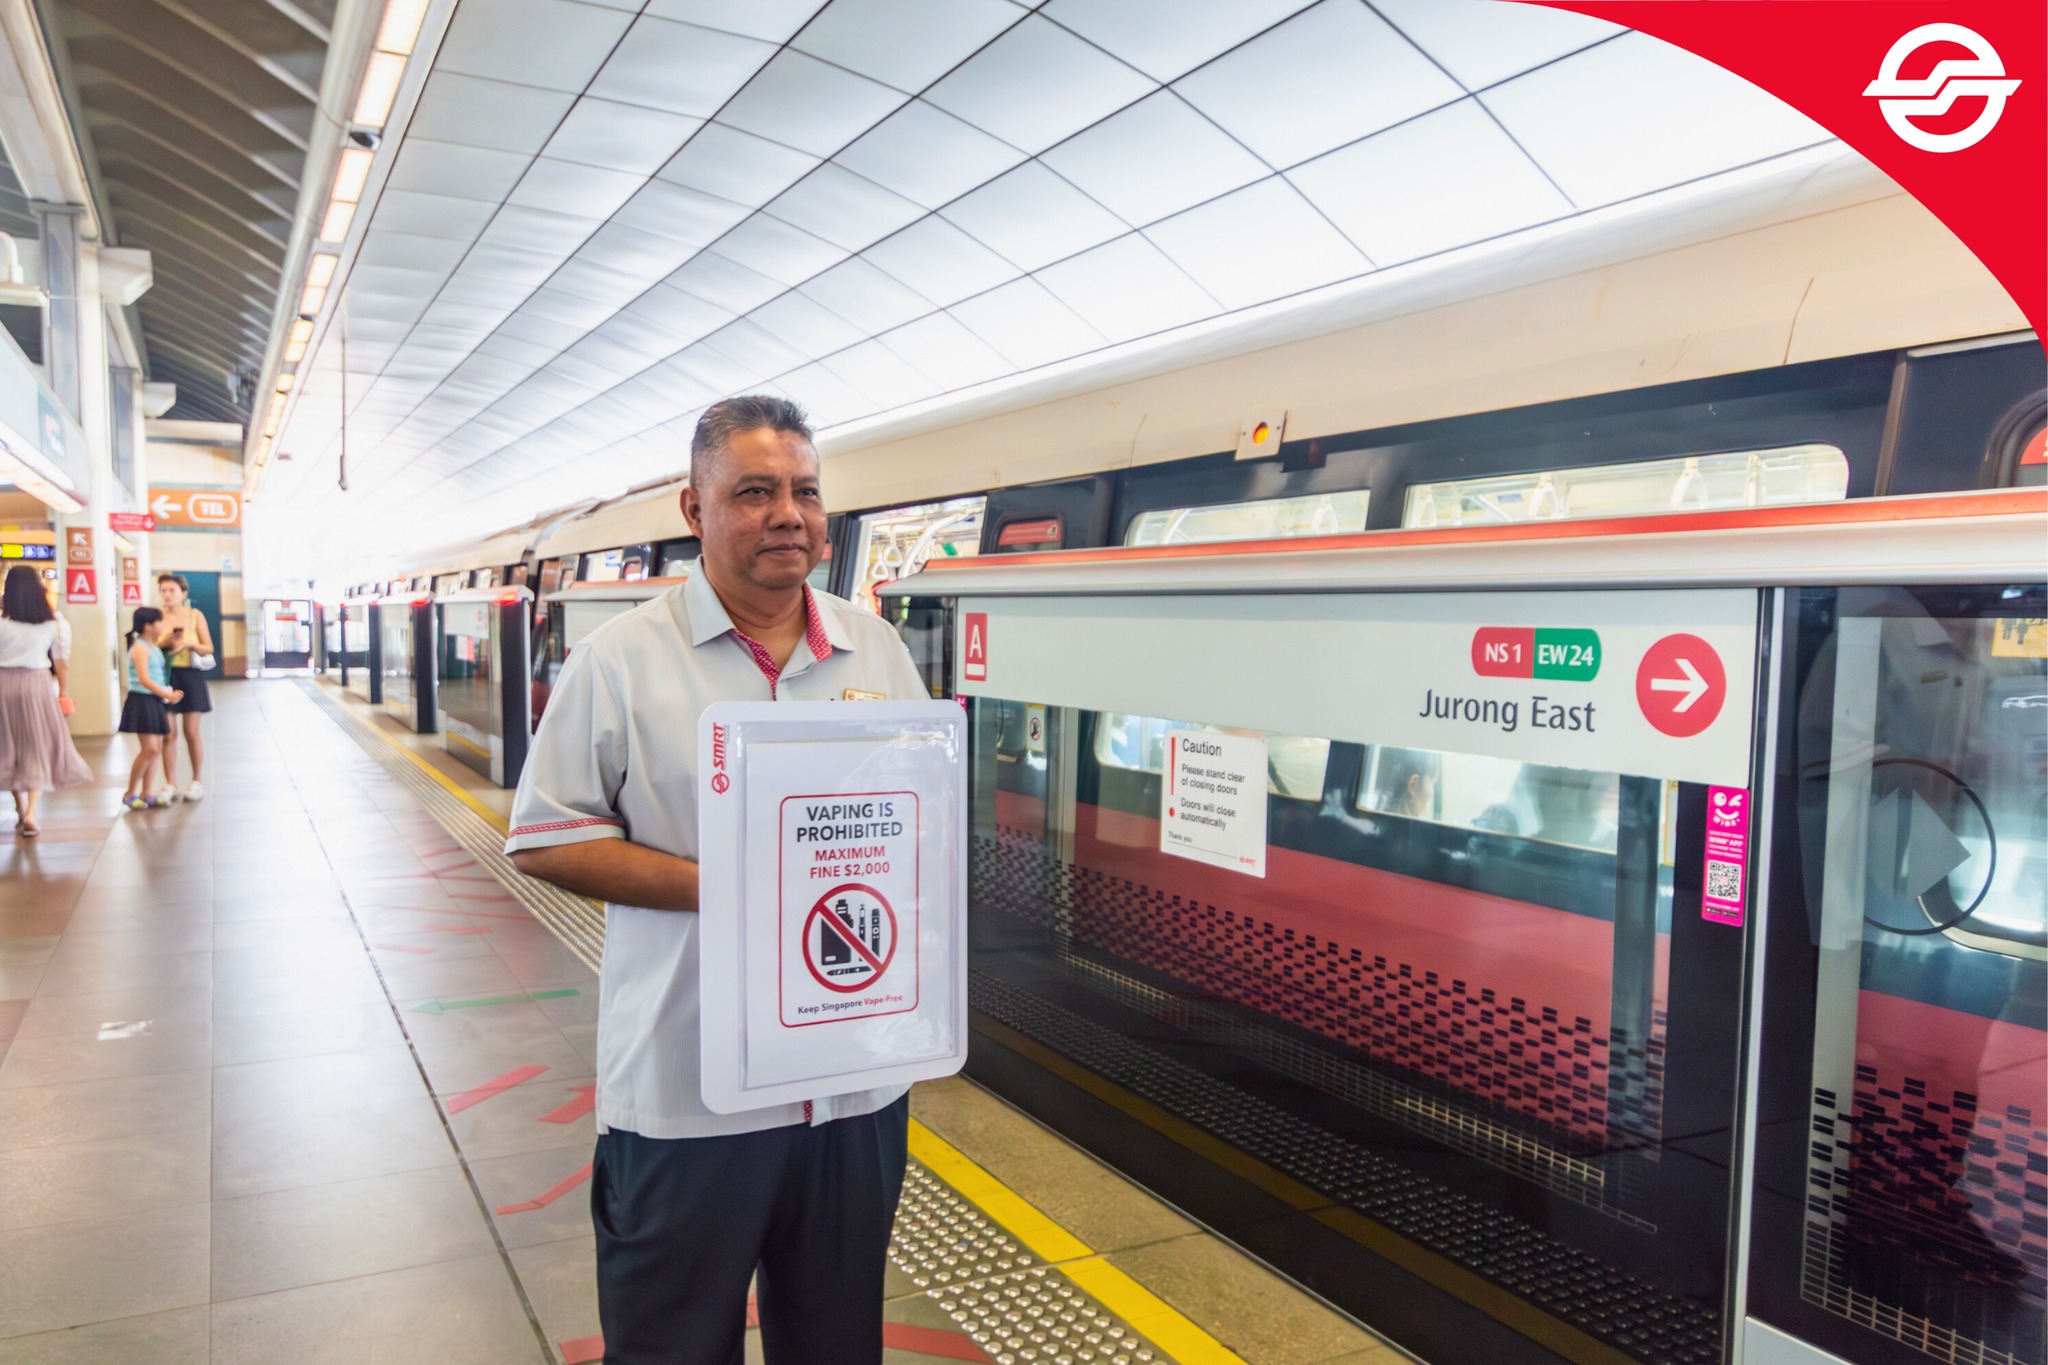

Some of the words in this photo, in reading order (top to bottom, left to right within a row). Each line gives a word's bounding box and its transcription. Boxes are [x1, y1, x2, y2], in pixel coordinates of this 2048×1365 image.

[200, 501, 227, 516] TEL
[73, 573, 91, 593] A
[128, 586, 138, 598] A
[969, 624, 983, 659] A
[1420, 689, 1519, 732] Jurong
[1531, 695, 1597, 732] East
[713, 722, 725, 770] SMRT
[1182, 738, 1222, 757] Caution
[1181, 763, 1204, 776] Please
[1206, 768, 1226, 780] stand
[1227, 771, 1246, 783] clear
[1181, 777, 1188, 786] of
[1189, 778, 1215, 793] closing
[1216, 783, 1238, 795] doors
[807, 803, 874, 821] VAPING
[879, 802, 893, 817] IS
[1181, 797, 1201, 811] Doors
[1203, 802, 1215, 813] will
[1216, 805, 1236, 818] close
[1180, 812, 1226, 831] automatically
[797, 821, 903, 842] PROHIBITED
[1168, 830, 1182, 841] Thank
[815, 845, 885, 862] MAXIMUM
[810, 865, 841, 879] FINE
[844, 861, 890, 877] $2,000
[798, 1006, 819, 1014] Keep
[821, 1000, 862, 1012] Singapore
[864, 995, 903, 1006] Vape-Free
